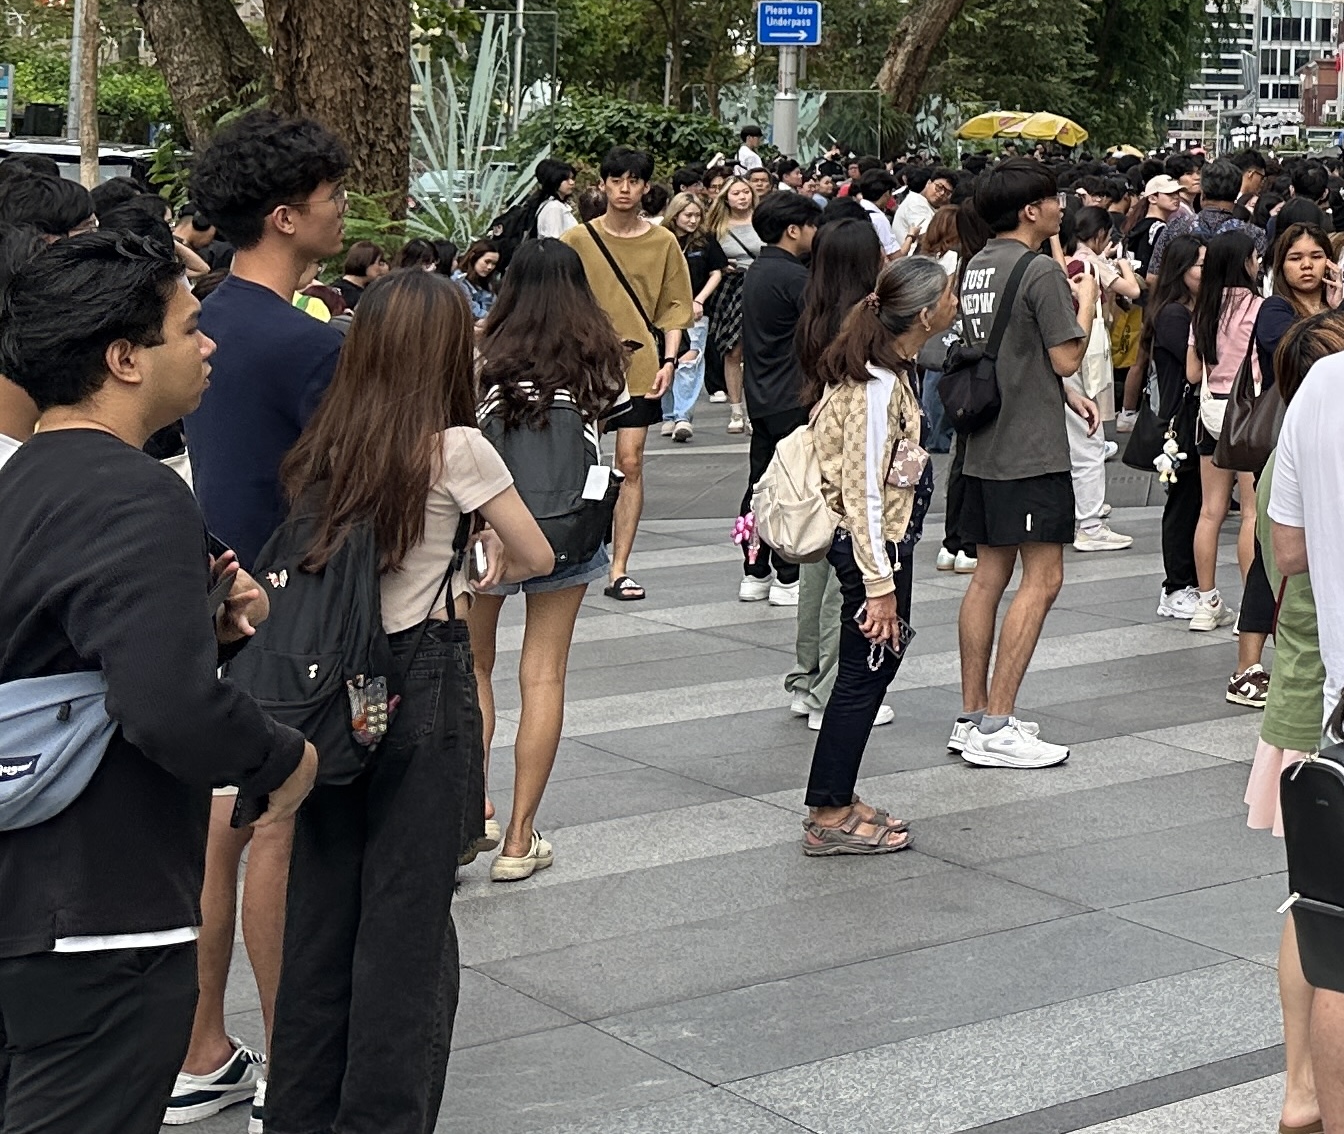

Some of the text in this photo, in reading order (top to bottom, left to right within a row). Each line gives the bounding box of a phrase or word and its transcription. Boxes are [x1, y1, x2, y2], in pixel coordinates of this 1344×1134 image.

[764, 5, 814, 15] Please Use
[766, 16, 812, 28] Underpass
[962, 268, 996, 291] JUST
